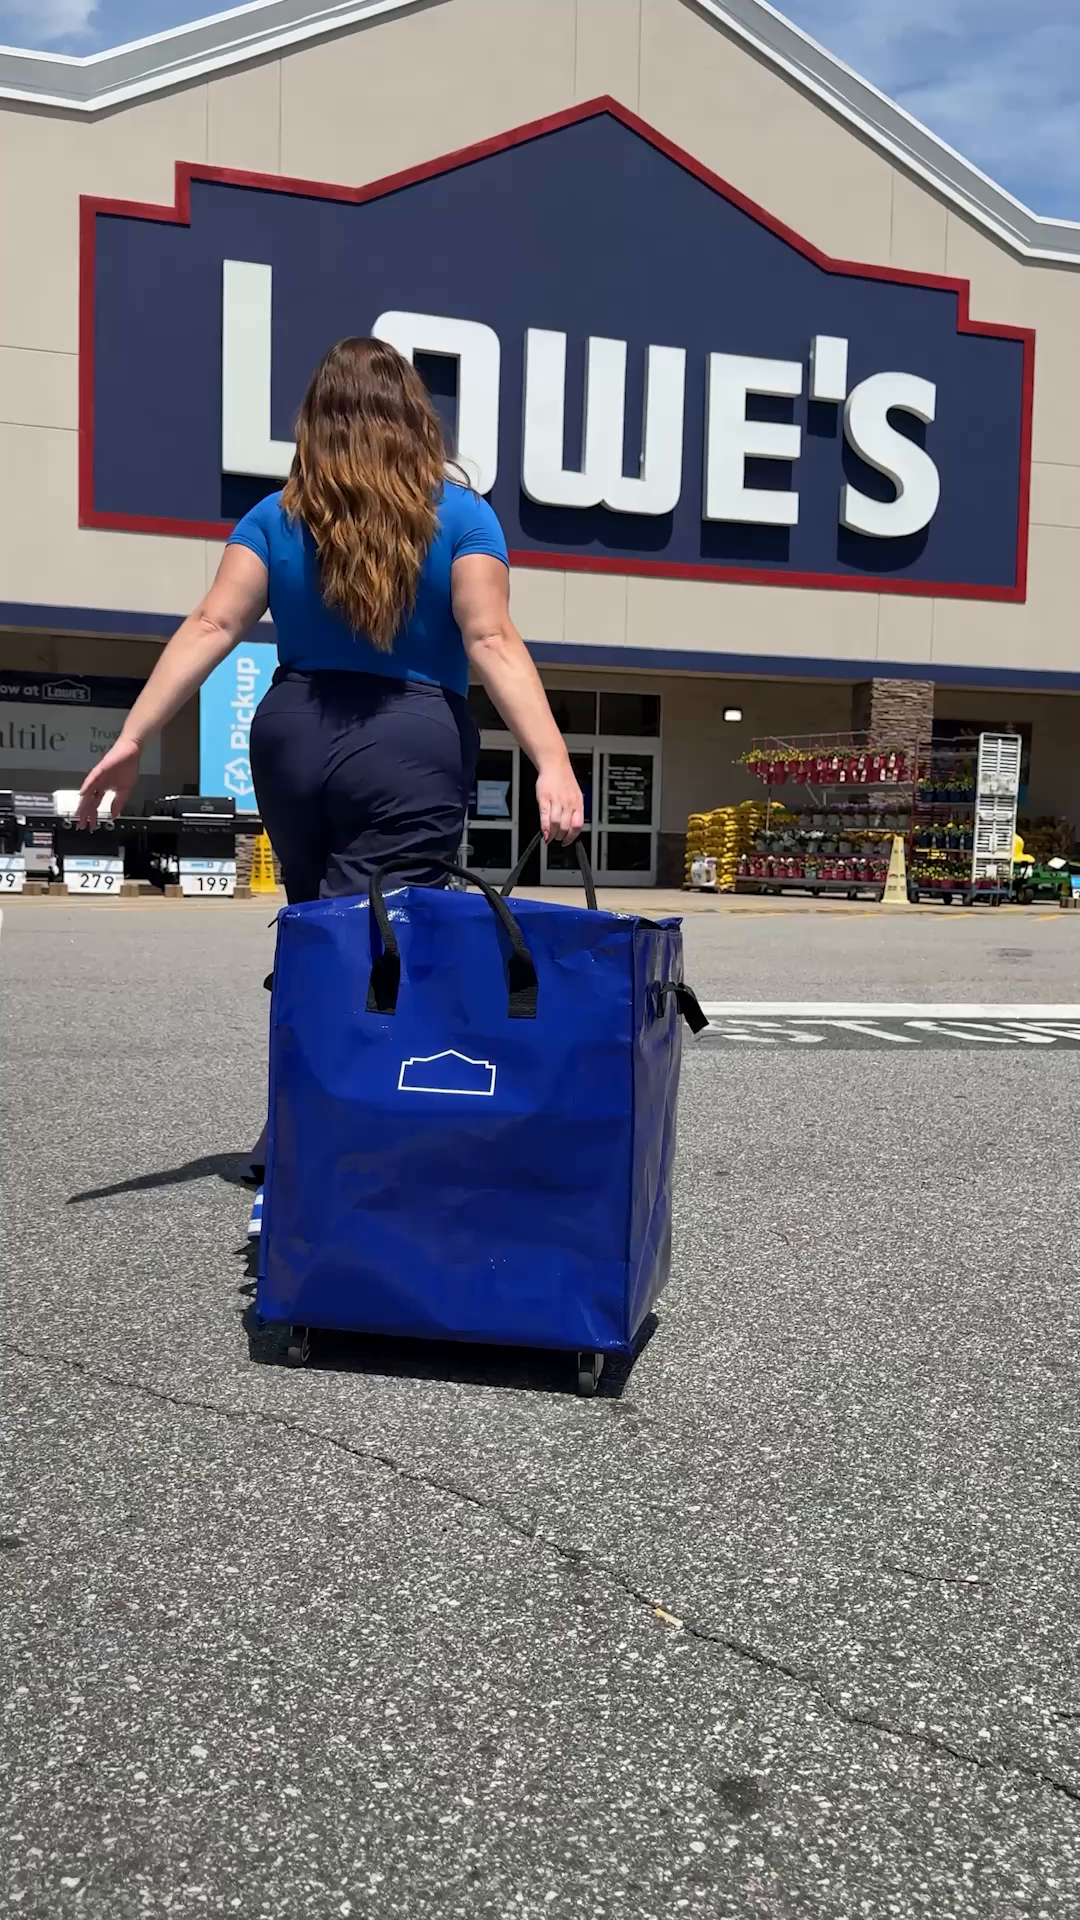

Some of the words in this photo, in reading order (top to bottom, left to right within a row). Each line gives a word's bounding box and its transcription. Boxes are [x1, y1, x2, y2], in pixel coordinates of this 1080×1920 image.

[221, 259, 940, 538] LOWE'S
[23, 685, 40, 696] at
[230, 657, 261, 749] Pickup
[80, 872, 114, 890] 279
[197, 876, 229, 892] 199
